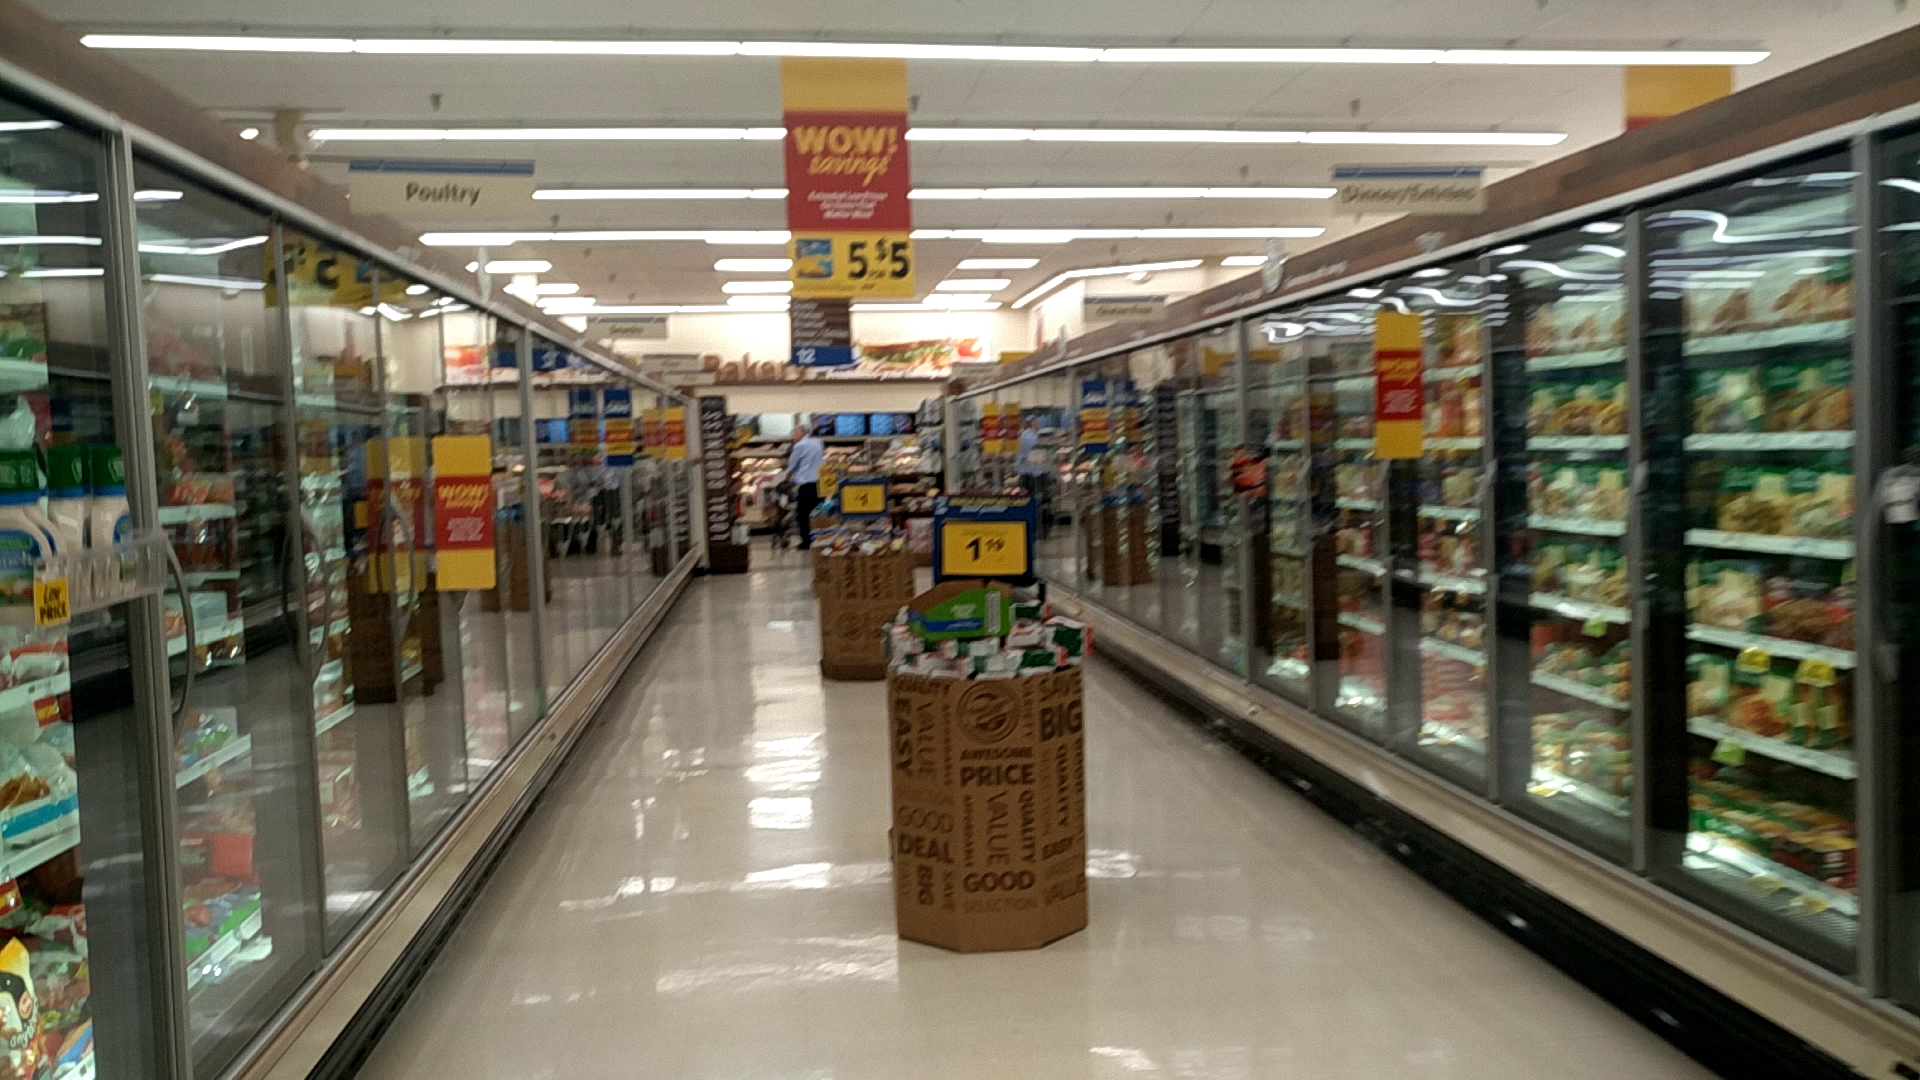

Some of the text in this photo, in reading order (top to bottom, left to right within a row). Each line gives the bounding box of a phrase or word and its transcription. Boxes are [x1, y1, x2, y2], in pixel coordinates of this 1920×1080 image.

[792, 126, 898, 155] WOW!
[808, 154, 892, 187] savings
[405, 182, 481, 207] Poultry
[848, 241, 868, 279] 5
[796, 348, 816, 364] 12
[39, 603, 68, 625] PRICE
[1040, 699, 1083, 742] BIG
[896, 698, 913, 777] EASY
[916, 702, 936, 779] VALUE
[961, 763, 1036, 788] PRICE
[898, 804, 954, 834] GOOD
[987, 790, 1010, 866] VALUE
[1019, 789, 1036, 863] QUALITY
[898, 832, 955, 864] DEAL
[917, 864, 935, 906] BIG
[963, 869, 1037, 893] GOOD
